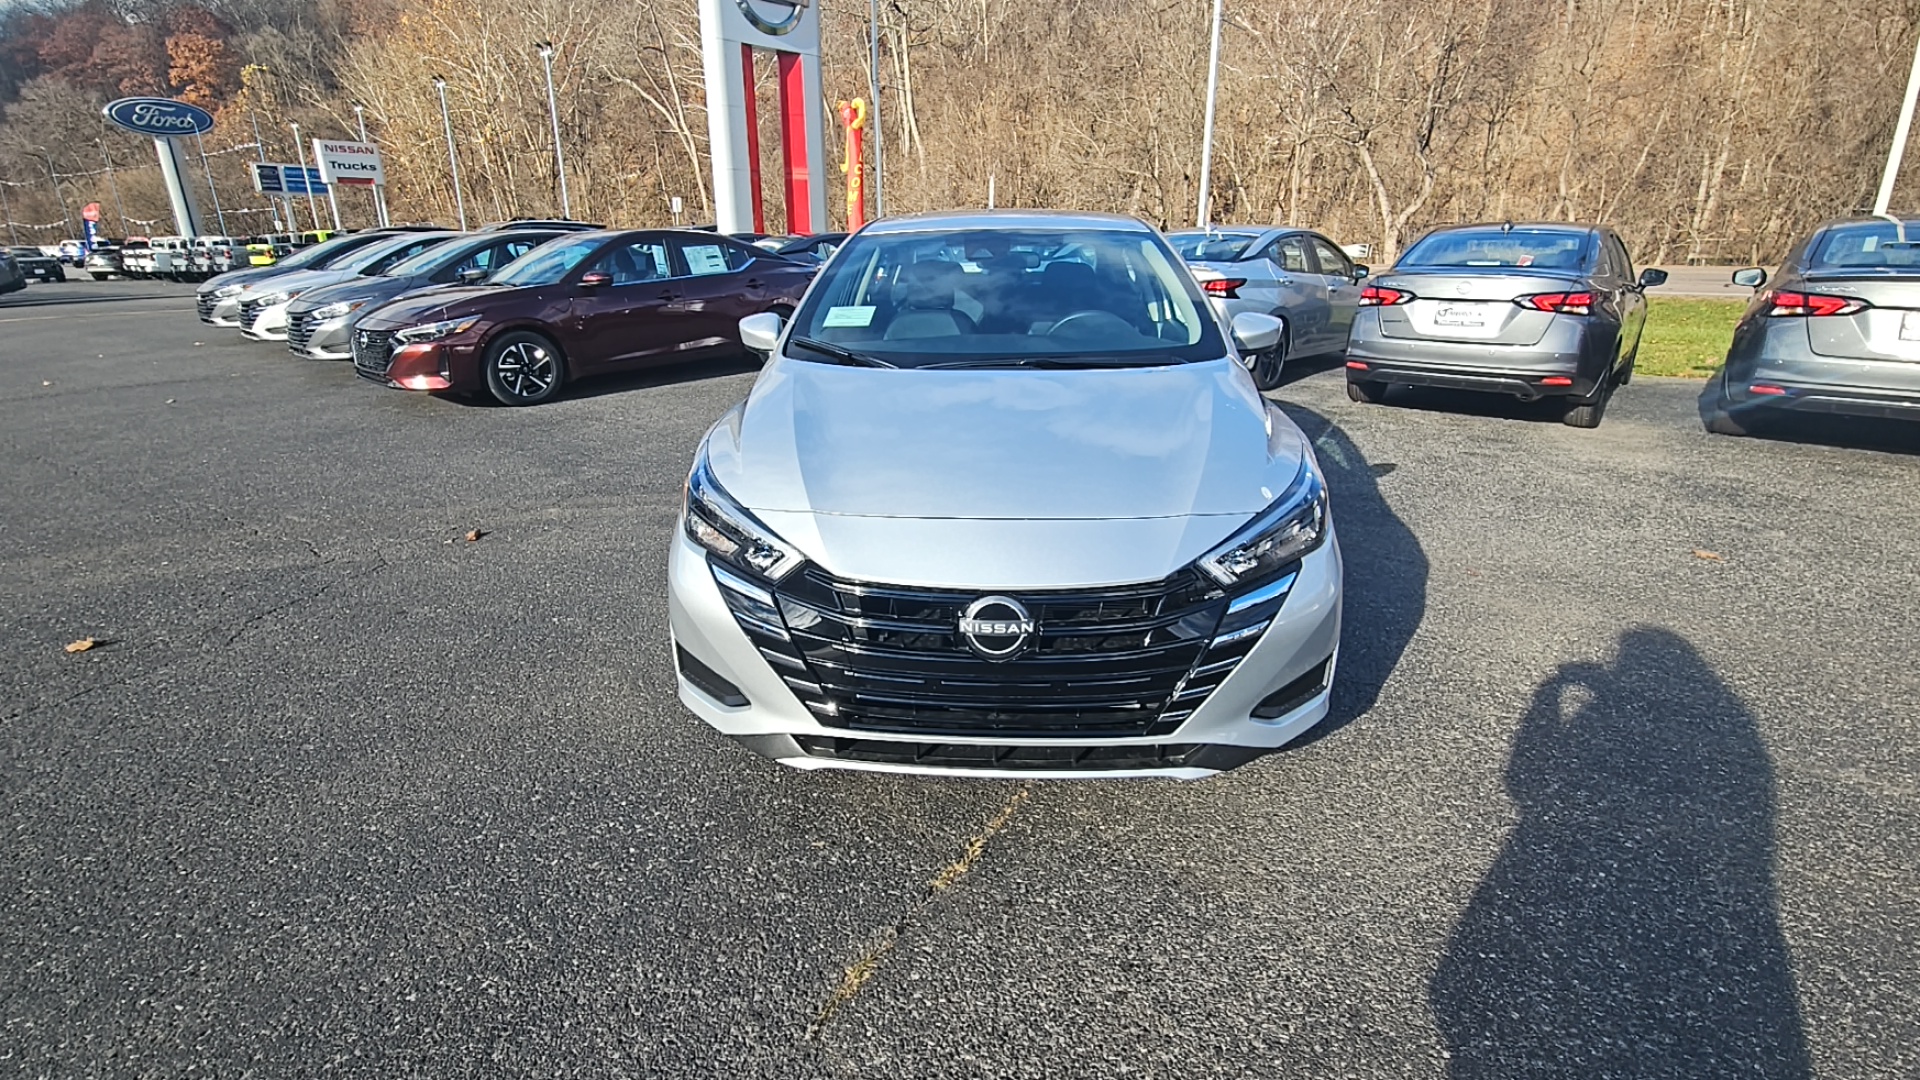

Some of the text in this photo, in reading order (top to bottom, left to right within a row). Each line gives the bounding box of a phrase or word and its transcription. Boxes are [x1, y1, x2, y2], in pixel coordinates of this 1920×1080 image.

[132, 104, 195, 128] Ford
[324, 144, 374, 154] NISSAN
[329, 160, 377, 171] Trucks
[960, 622, 1034, 634] NISSAN
